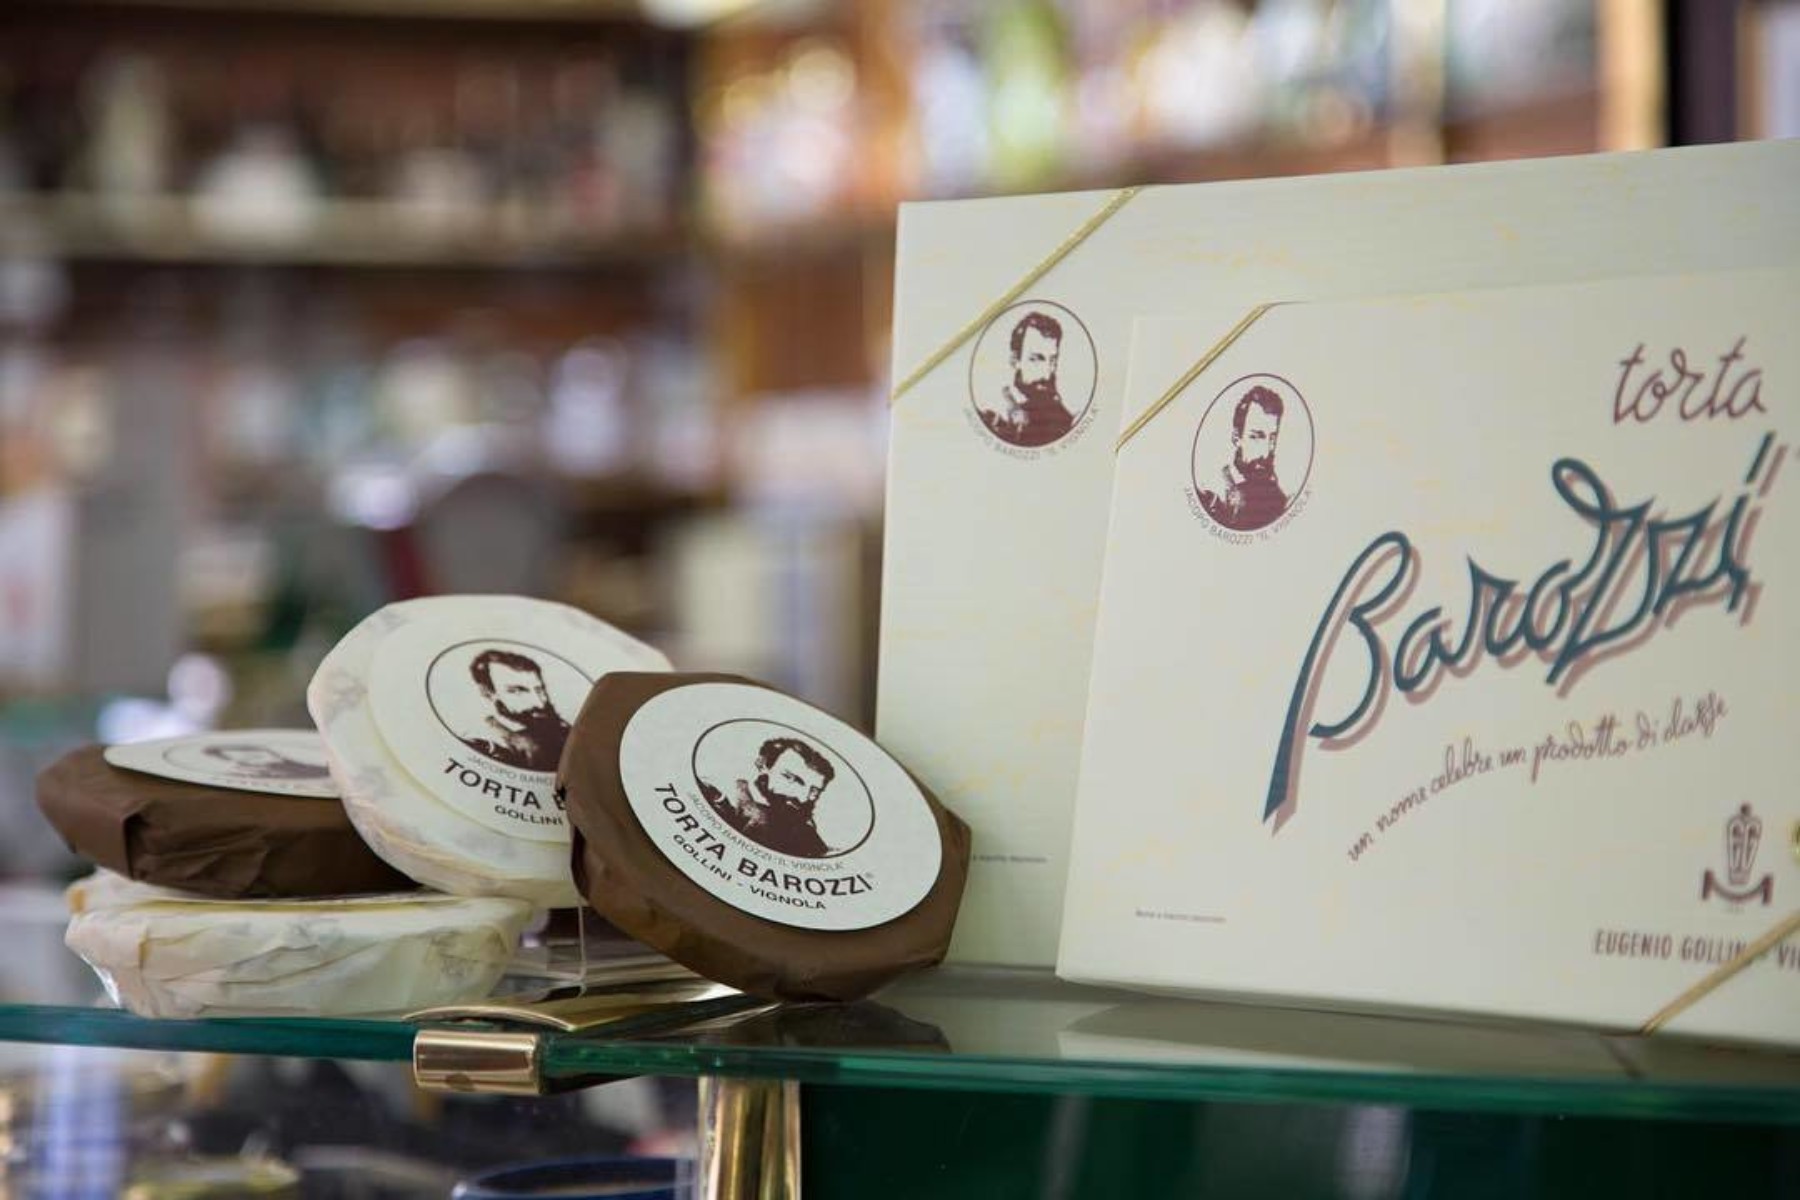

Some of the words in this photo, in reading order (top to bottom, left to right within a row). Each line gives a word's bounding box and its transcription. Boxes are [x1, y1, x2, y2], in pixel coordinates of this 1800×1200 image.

[1613, 336, 1767, 425] torta
[1209, 524, 1255, 545] BAROZZI
[1262, 431, 1788, 836] Barozzi
[443, 757, 542, 810] TORTA
[493, 803, 563, 827] GOLLINI
[1348, 832, 1374, 862] un
[1376, 786, 1429, 832] nome
[1430, 735, 1495, 794] celebre
[1499, 747, 1527, 768] un
[1529, 713, 1634, 785] prodotto
[1635, 711, 1658, 750] di
[654, 782, 726, 861] TORTA
[720, 828, 773, 861] BAROZZI
[672, 833, 733, 881] GOLLINI
[750, 884, 827, 910] VIGNOLA
[1594, 928, 1673, 961] EUGENIO
[1680, 936, 1752, 964] GOLLIN
[1777, 943, 1800, 972] VI
